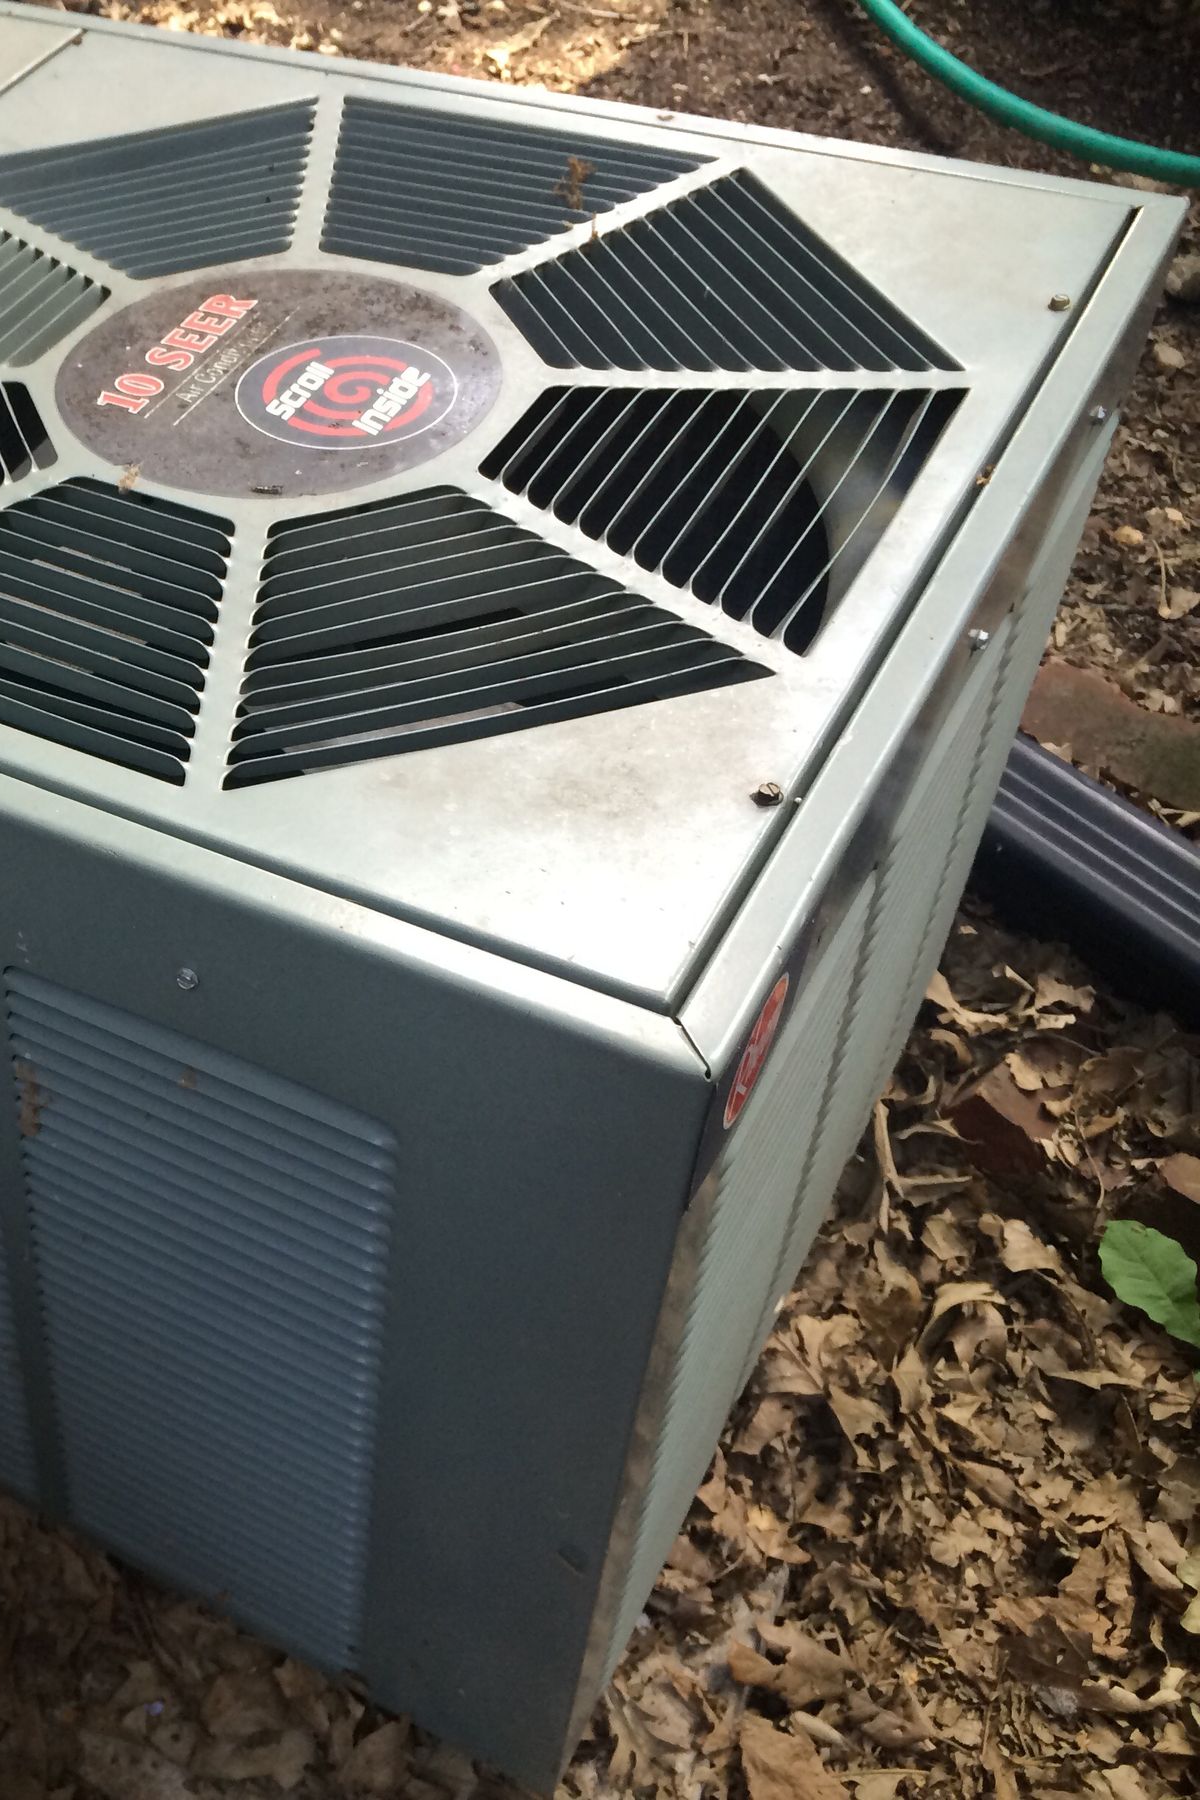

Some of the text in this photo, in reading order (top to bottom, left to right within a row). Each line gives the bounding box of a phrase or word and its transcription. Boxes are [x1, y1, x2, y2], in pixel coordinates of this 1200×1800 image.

[97, 294, 259, 414] 10 SEER
[175, 384, 205, 403] Air
[266, 361, 335, 420] Scroll
[352, 366, 432, 436] Inside
